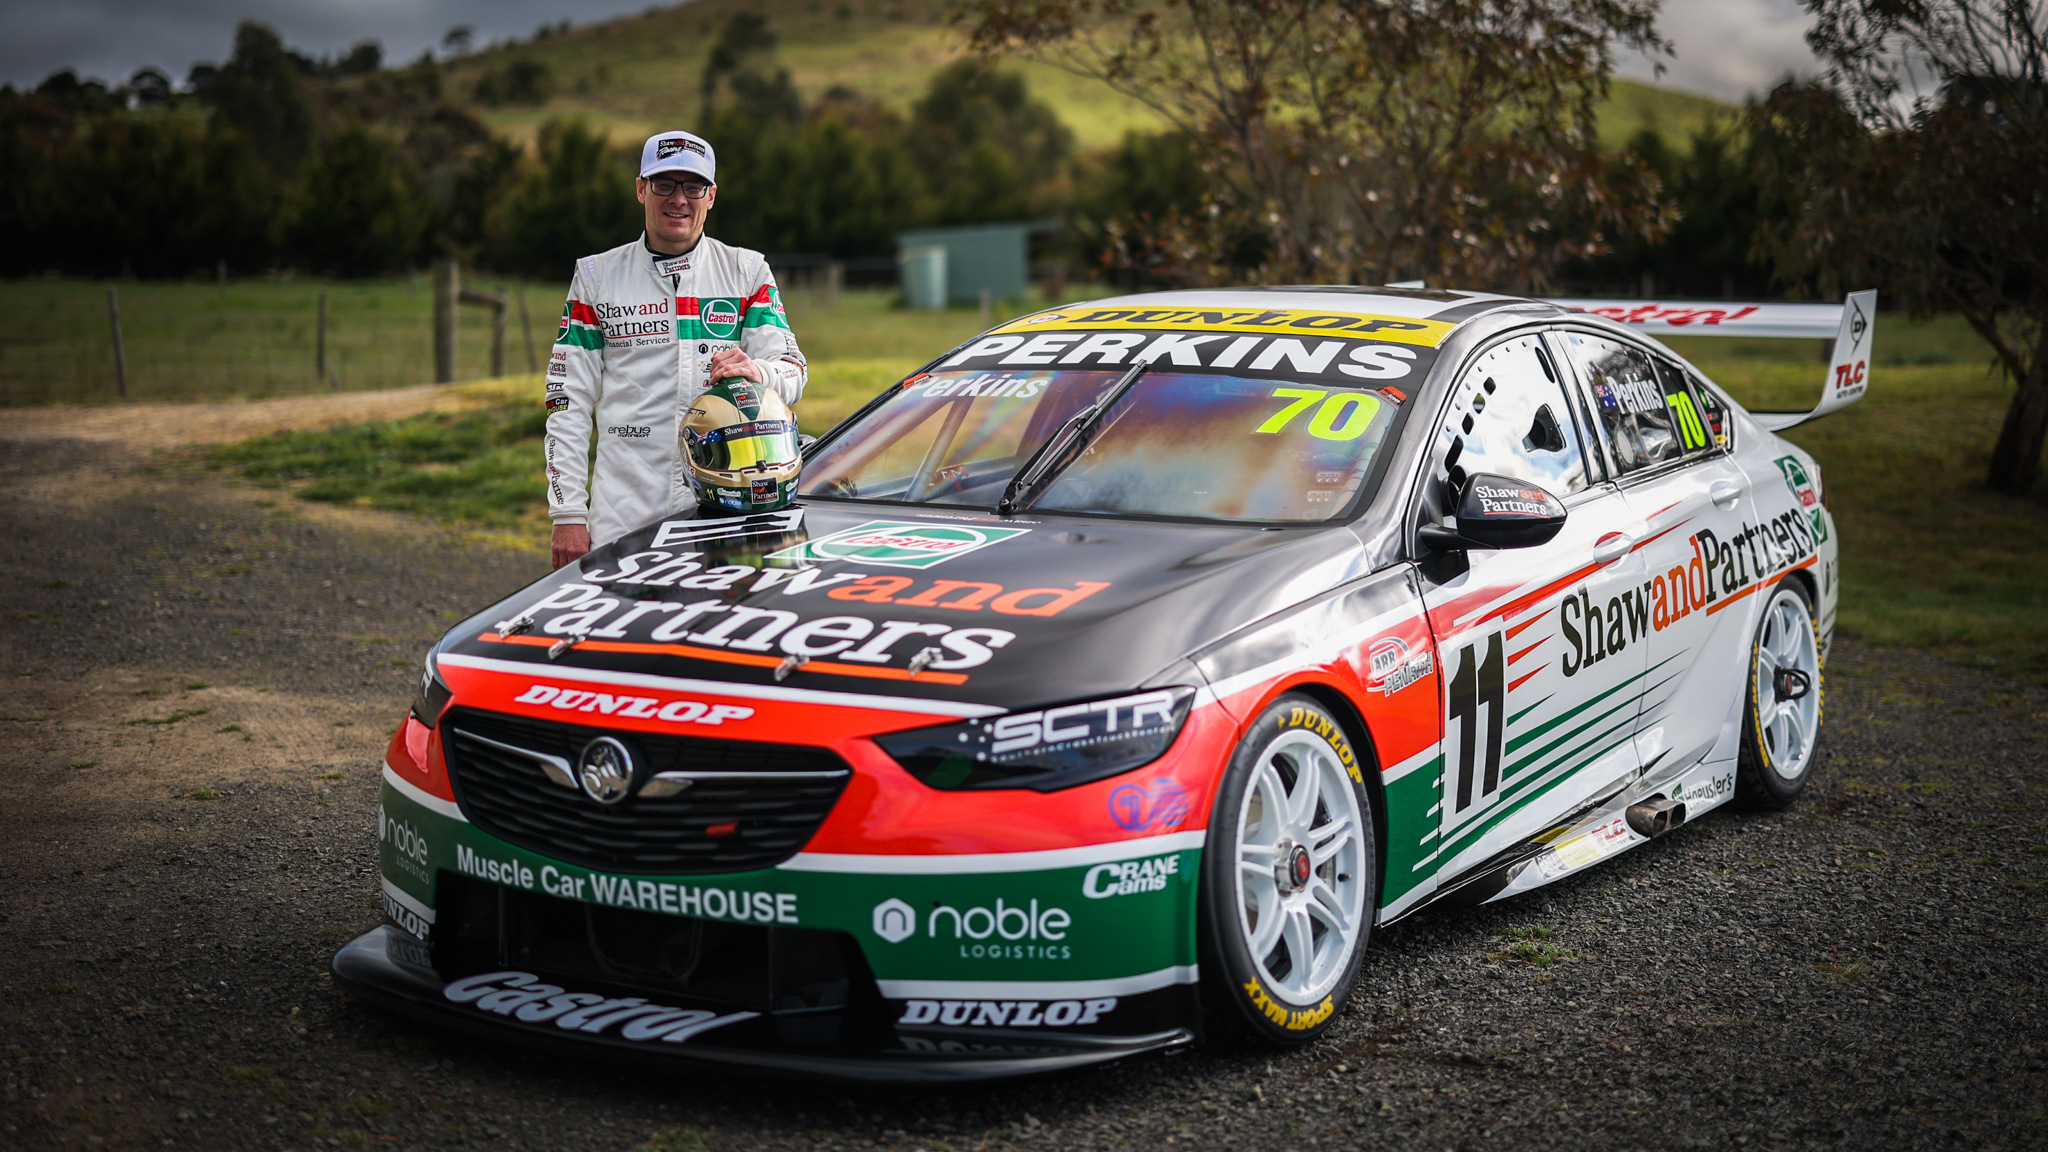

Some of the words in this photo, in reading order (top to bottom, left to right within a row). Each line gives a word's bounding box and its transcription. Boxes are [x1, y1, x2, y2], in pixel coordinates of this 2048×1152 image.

[600, 319, 670, 338] Partners
[708, 313, 736, 323] Castrol
[1067, 310, 1429, 333] DUNLOP
[636, 337, 670, 346] Services
[941, 333, 1417, 380] PERKINS
[896, 373, 1049, 400] Perkins
[1609, 371, 1664, 415] Perkins
[1836, 359, 1866, 389] TLC
[608, 425, 651, 435] erebus
[1255, 387, 1381, 441] 70
[1666, 390, 1706, 449] 70
[1479, 498, 1548, 516] Partners
[846, 535, 972, 550] Castrol
[494, 583, 1017, 670] Partners
[514, 684, 755, 725] DUNLOP
[991, 689, 1174, 754] SCTR
[1449, 630, 1504, 815] 11
[1289, 706, 1364, 785] DUNLOP
[387, 817, 428, 866] noble
[396, 854, 430, 885] LOGISTICS
[456, 844, 534, 889] Muscle
[540, 864, 586, 899] Car
[589, 874, 799, 924] WAREHOUSE
[383, 893, 430, 940] UNLOP
[928, 897, 1072, 941] noble
[960, 944, 1072, 960] LOGISTICS
[443, 970, 763, 1043] Castrol
[899, 997, 1118, 1026] DUNLOP
[1243, 975, 1288, 1027] MAXX
[1286, 993, 1334, 1030] SPORT
